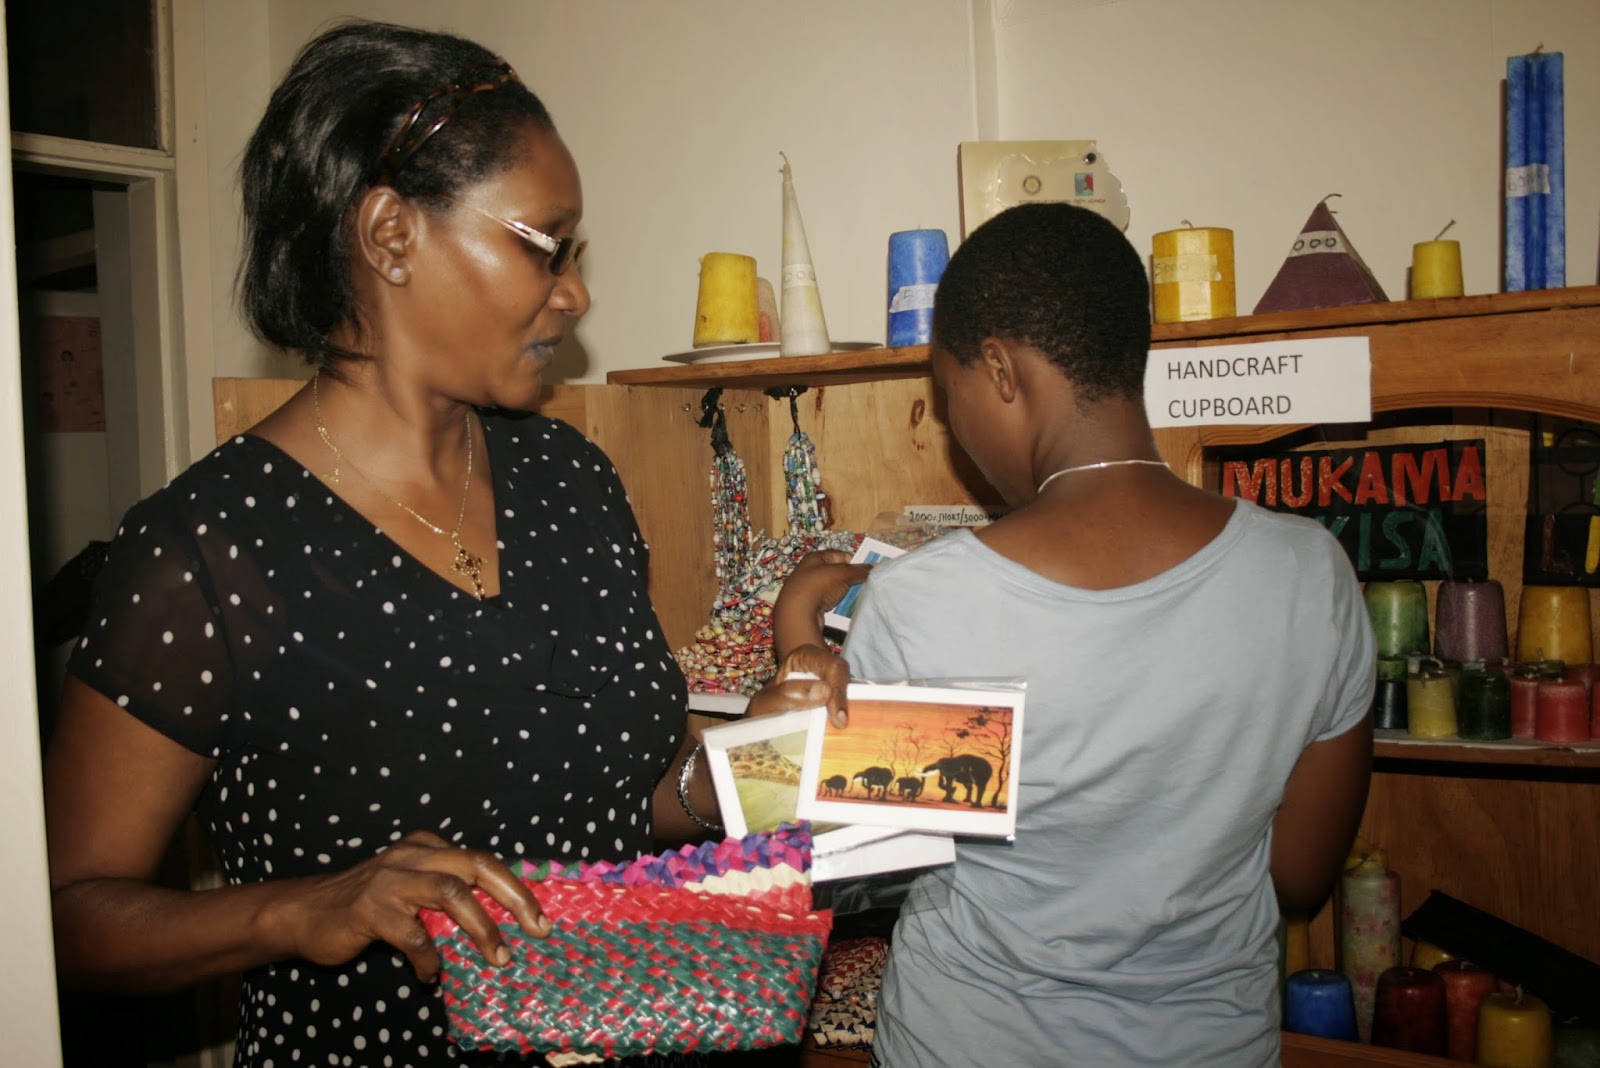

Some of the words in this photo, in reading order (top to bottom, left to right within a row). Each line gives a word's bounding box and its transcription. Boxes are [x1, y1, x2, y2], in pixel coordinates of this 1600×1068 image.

[1168, 354, 1303, 380] HANDCRAFT
[1168, 396, 1292, 419] CUPBOARD
[1222, 446, 1486, 508] MUKAMA
